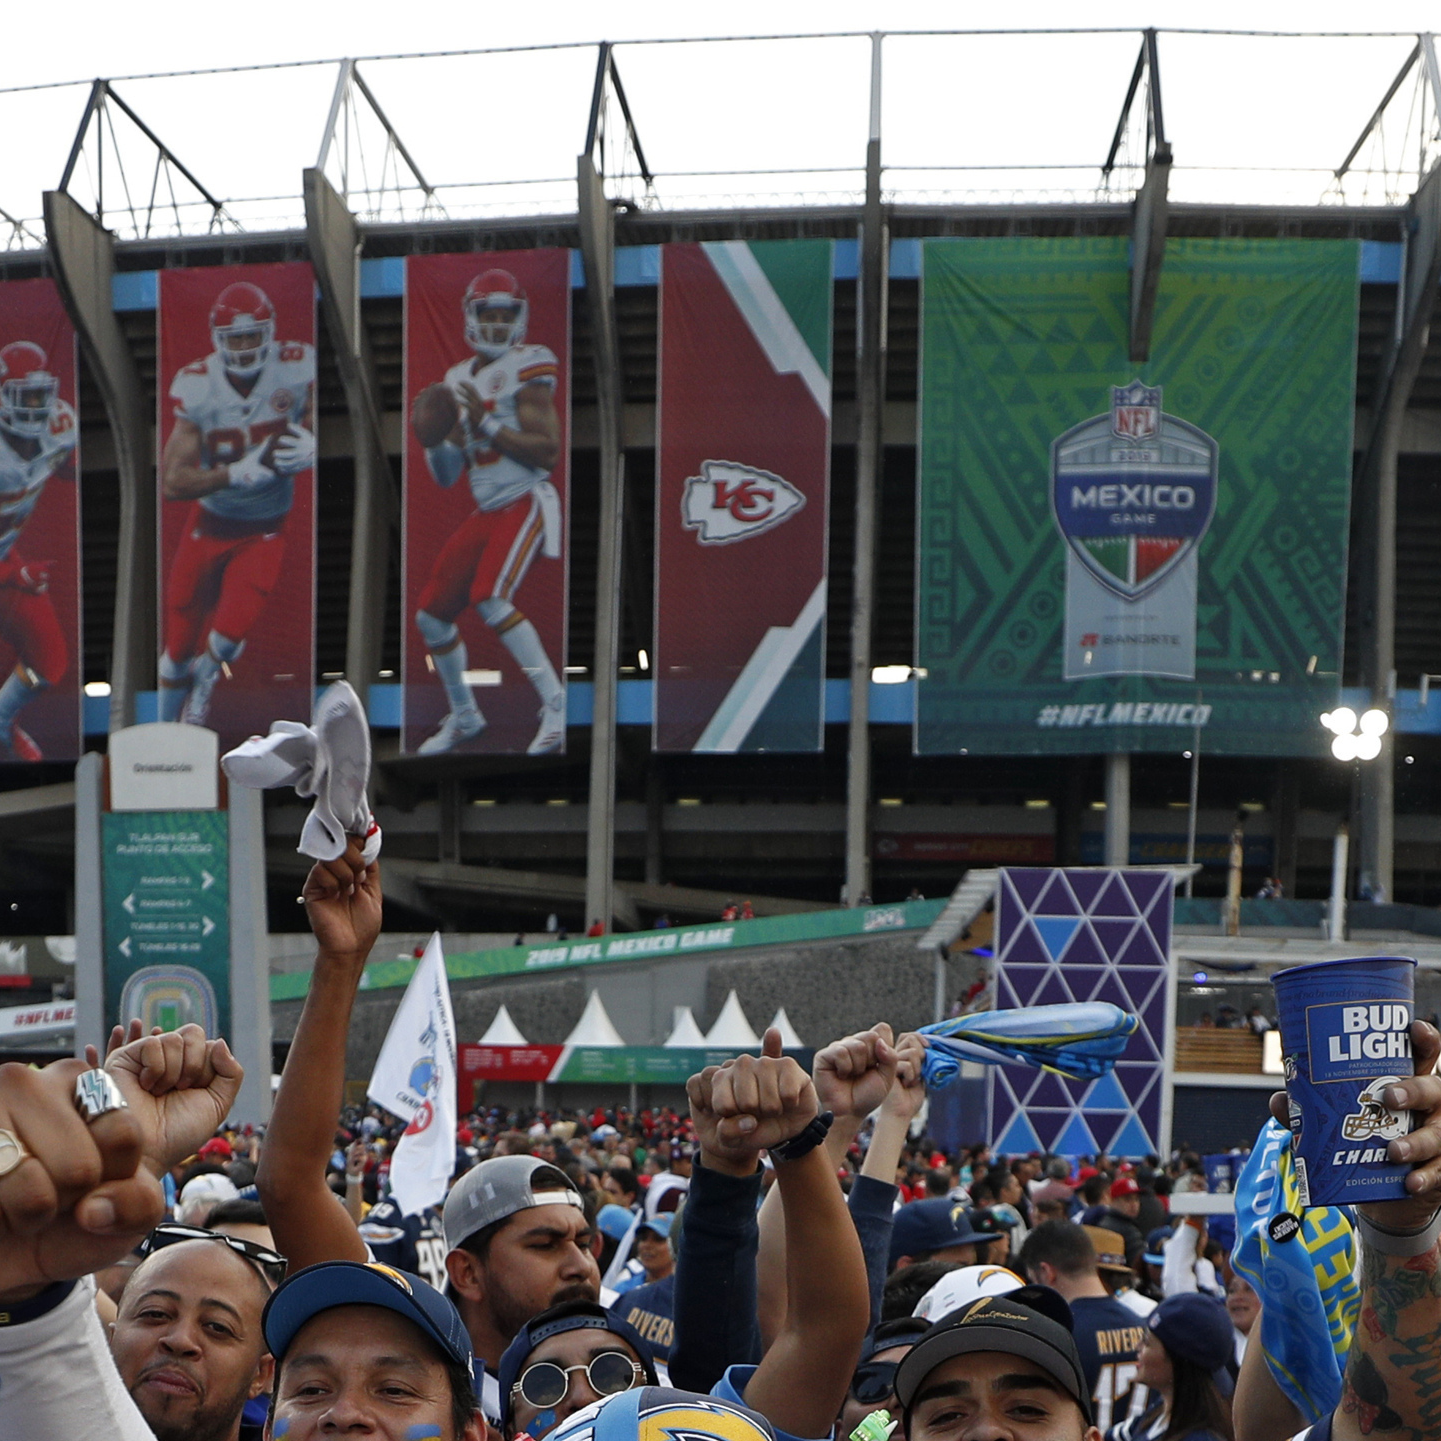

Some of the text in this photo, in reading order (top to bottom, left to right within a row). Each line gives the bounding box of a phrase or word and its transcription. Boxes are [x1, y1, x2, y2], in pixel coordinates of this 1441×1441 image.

[1117, 407, 1155, 435] NFL
[712, 479, 775, 522] KC
[1070, 484, 1196, 509] MEXICO
[1110, 513, 1157, 525] GAME
[1102, 633, 1180, 646] BANORTE
[1037, 702, 1213, 727] #NFLMEXICO
[132, 761, 193, 774] Orientación
[569, 942, 602, 961] NFL
[605, 933, 678, 957] MEXICO
[678, 928, 735, 948] GAME
[14, 1008, 76, 1026] #NFLME
[1342, 1004, 1409, 1034] BUD
[1333, 1069, 1369, 1078] NOVIEMBRE
[1332, 1148, 1390, 1166] CHAR
[1345, 1175, 1407, 1187] EDICIÓN ESPE
